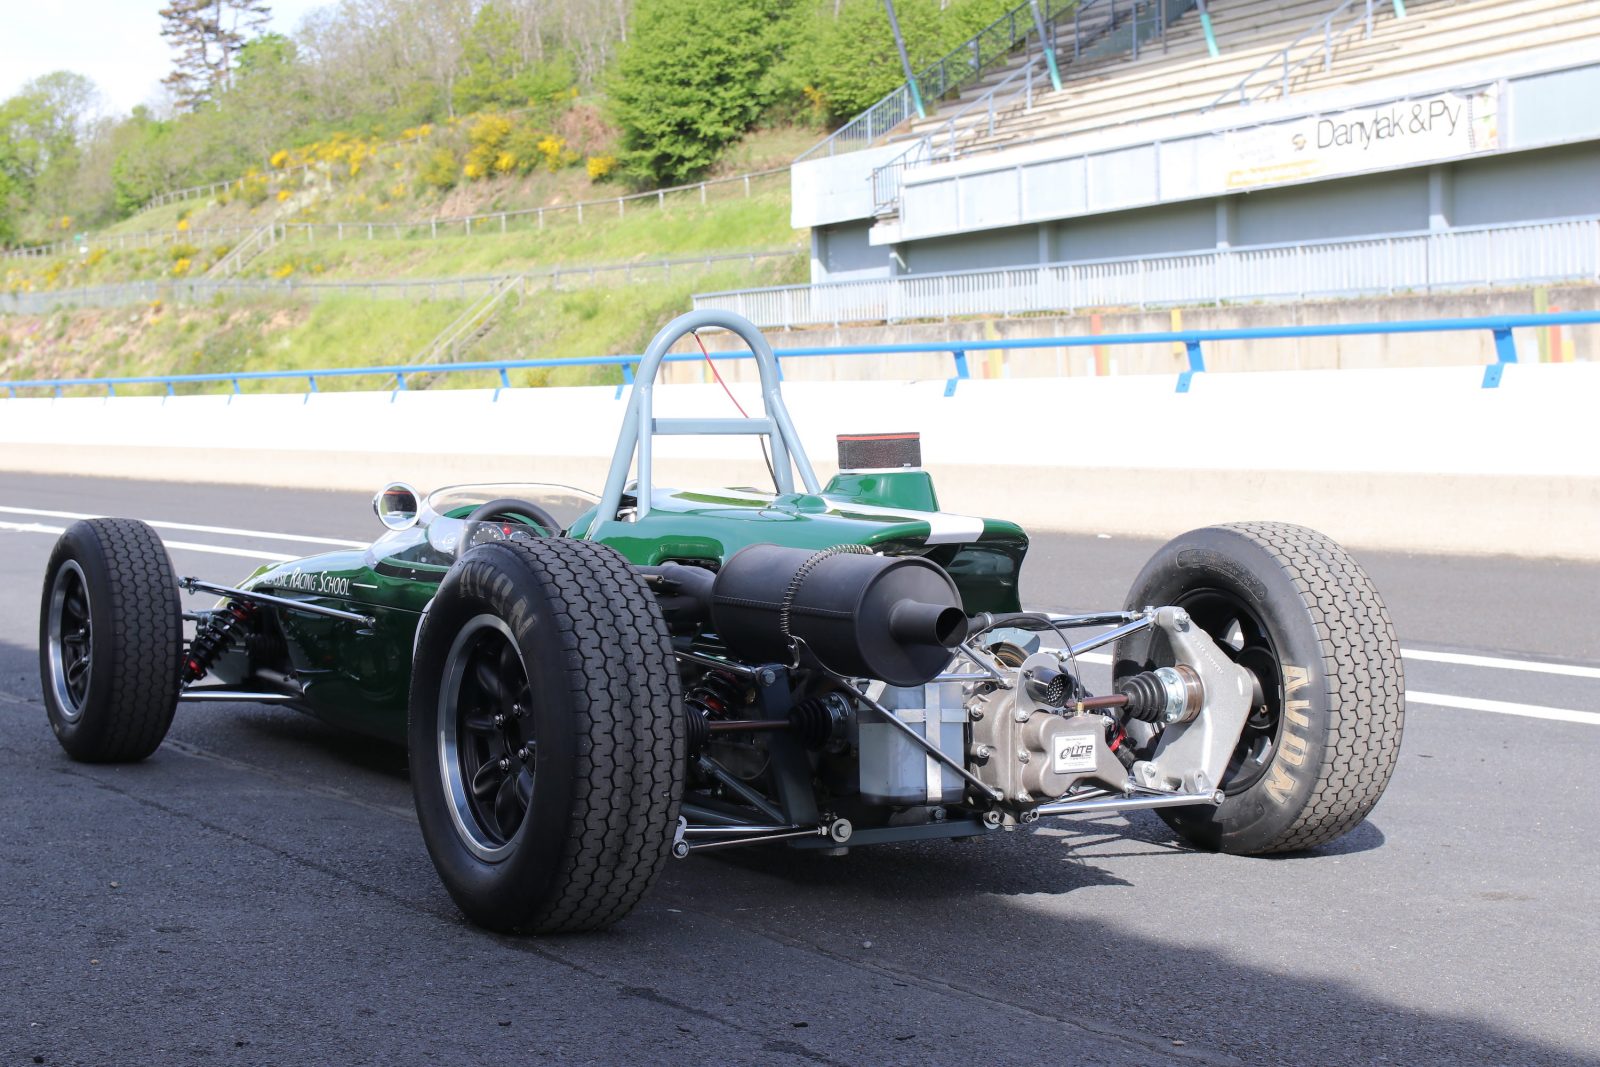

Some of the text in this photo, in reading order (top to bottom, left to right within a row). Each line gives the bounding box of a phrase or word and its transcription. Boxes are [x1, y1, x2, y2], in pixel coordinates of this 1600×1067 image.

[318, 570, 350, 595] SCHOOL
[459, 561, 537, 641] AVON
[1265, 664, 1310, 804] AVON
